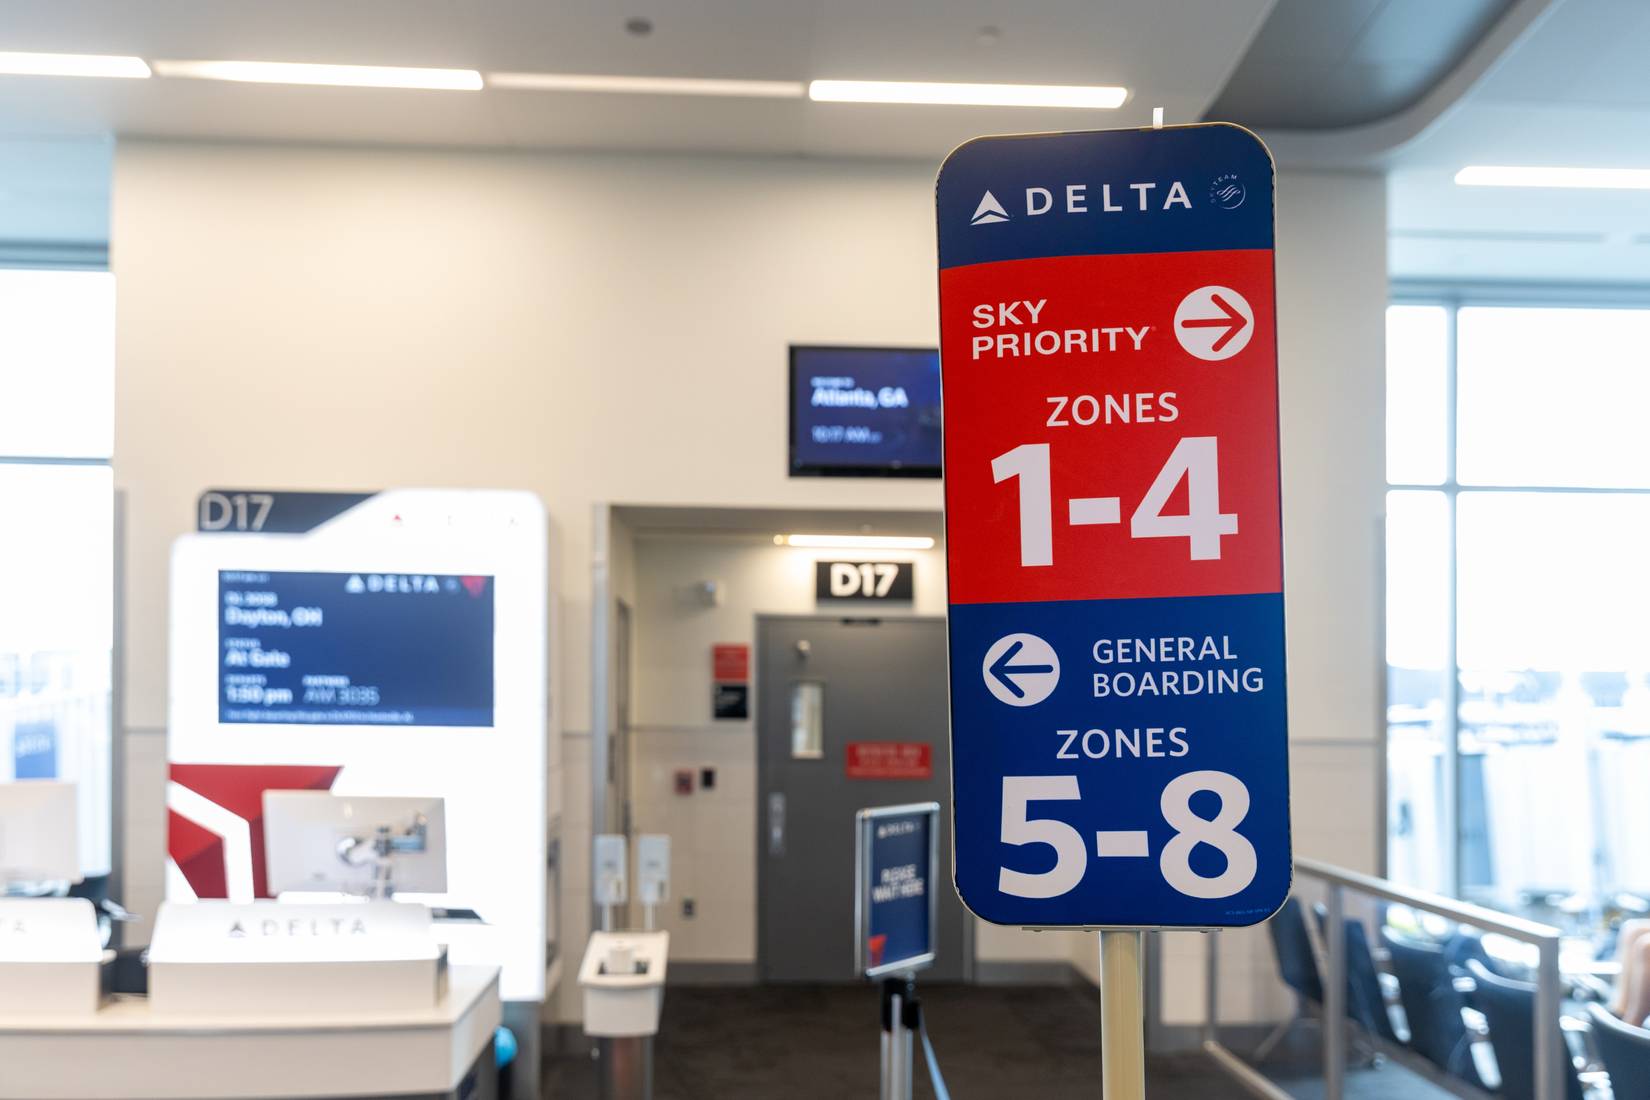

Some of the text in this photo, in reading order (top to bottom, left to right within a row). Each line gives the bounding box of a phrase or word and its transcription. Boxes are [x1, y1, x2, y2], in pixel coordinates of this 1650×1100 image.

[1025, 181, 1192, 216] DELTA
[972, 298, 1048, 330] SKY
[972, 325, 1150, 361] PRIORITY
[1046, 391, 1179, 427] ZONES
[199, 493, 273, 530] D17
[990, 436, 1239, 567] 1-4
[367, 574, 440, 593] DELTA
[831, 563, 899, 597] D17
[1092, 635, 1238, 664] GENERAL
[1092, 667, 1264, 698] BOARDING
[1056, 726, 1190, 760] ZONES
[998, 769, 1258, 899] 5-8
[261, 918, 366, 936] DELTA
